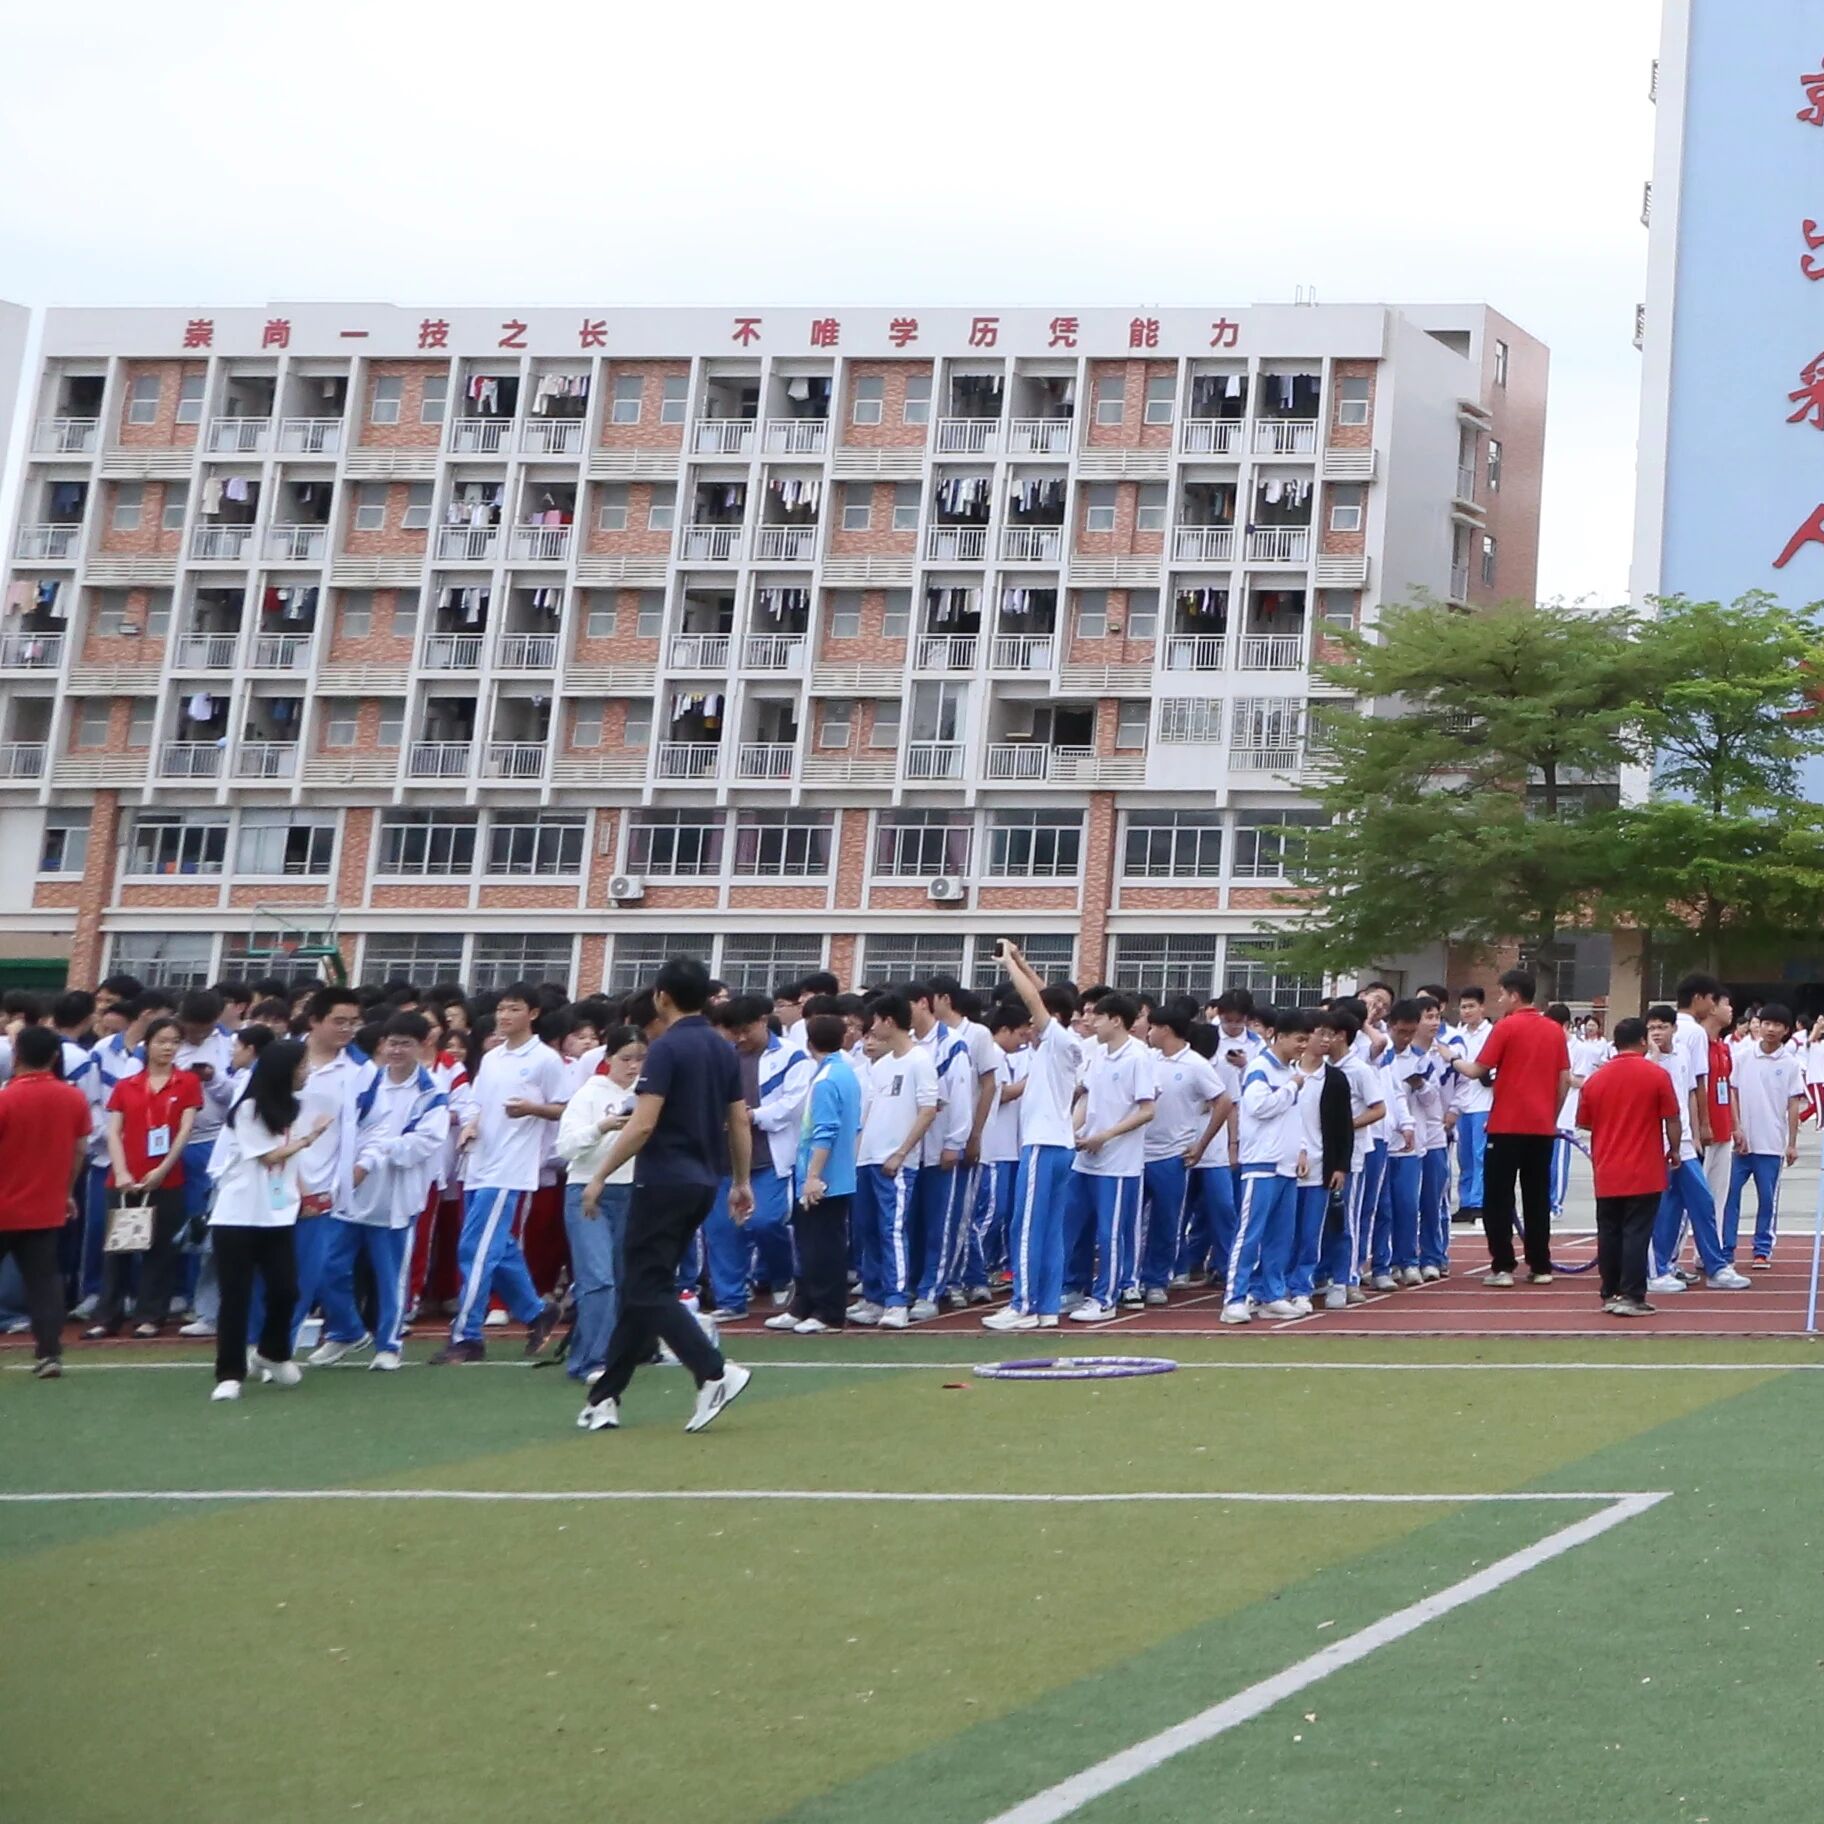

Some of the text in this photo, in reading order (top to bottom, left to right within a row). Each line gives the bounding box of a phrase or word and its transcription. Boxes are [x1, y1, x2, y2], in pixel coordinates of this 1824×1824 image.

[183, 317, 1240, 348] 崇尚一技之长 不唯学历凭能力
